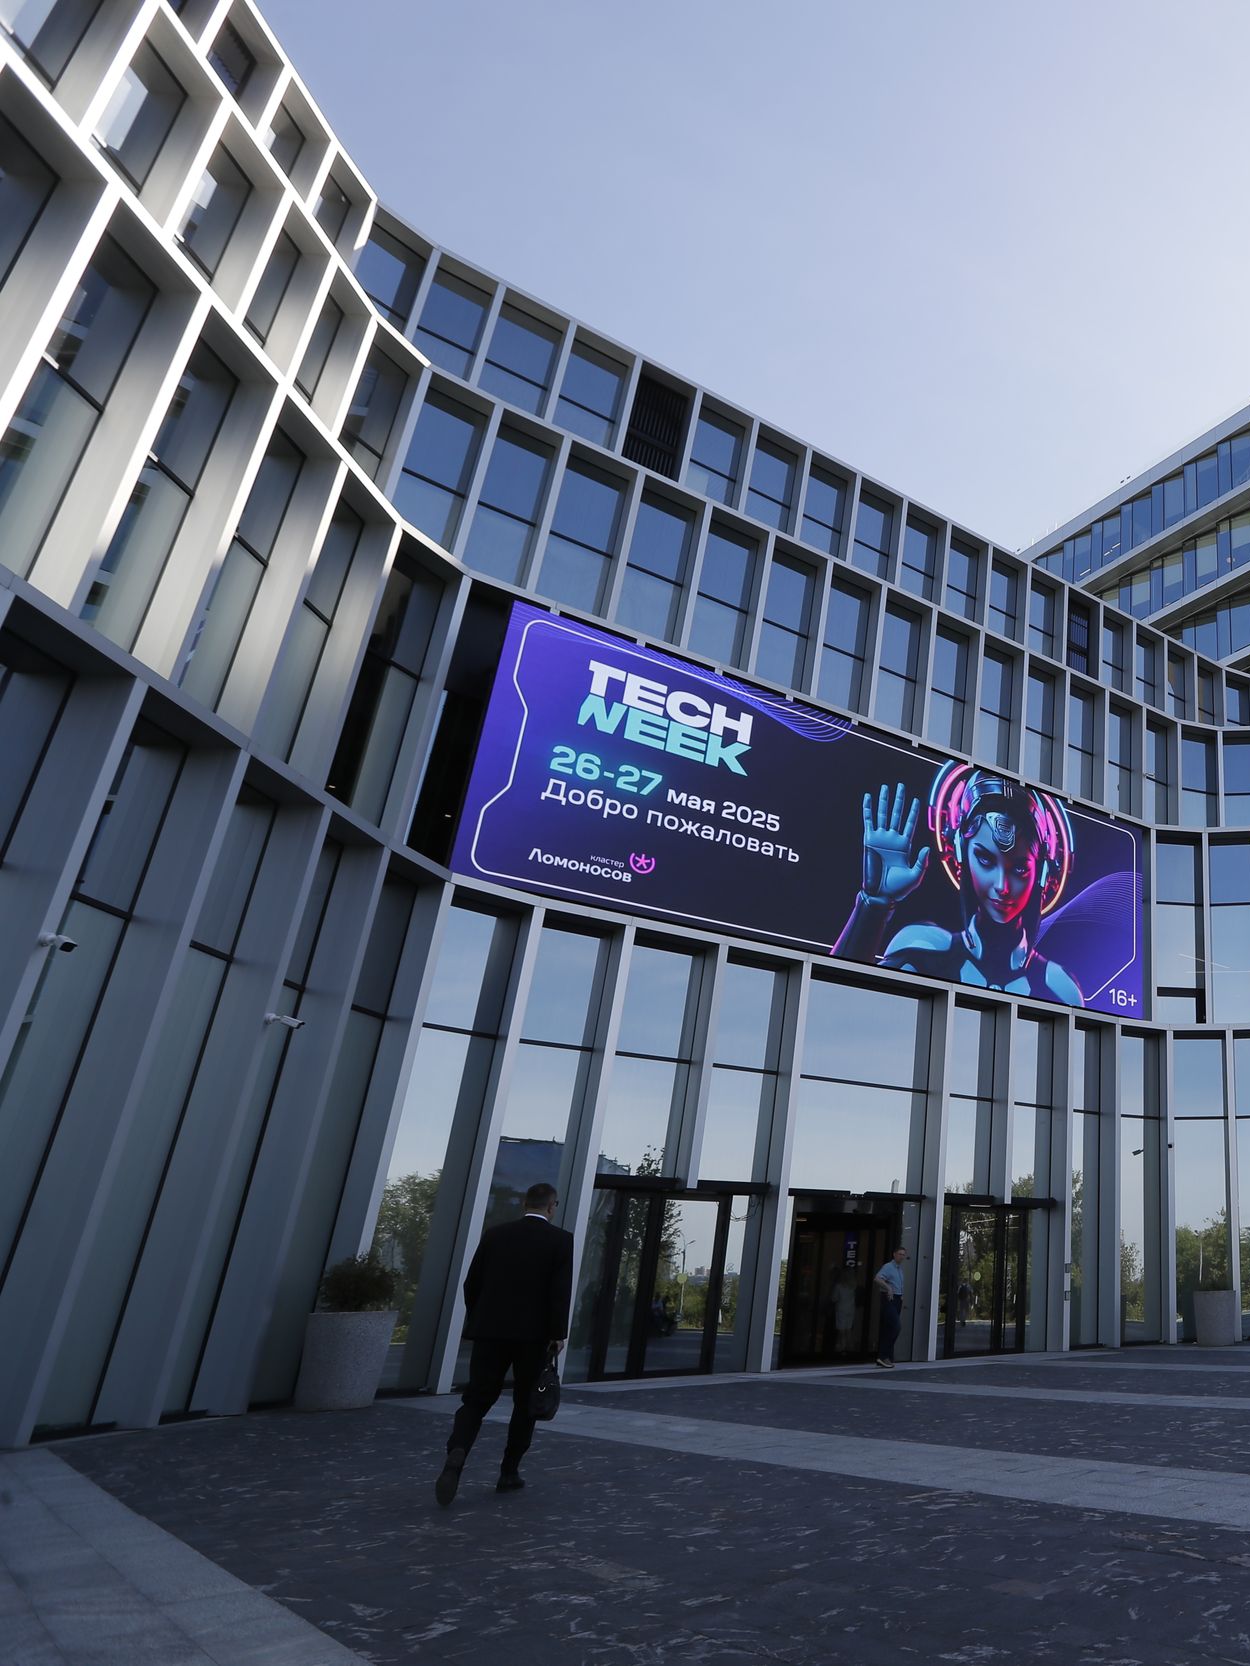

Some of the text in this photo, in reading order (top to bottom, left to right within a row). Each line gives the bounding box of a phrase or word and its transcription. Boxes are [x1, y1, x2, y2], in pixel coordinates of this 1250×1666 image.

[578, 694, 752, 776] WEEK
[589, 660, 753, 744] TECH
[540, 778, 800, 863] Добро пожаловать
[550, 745, 780, 832] 26-27 мая 2025
[528, 848, 632, 883] Ломоносов
[590, 855, 625, 868] кластер
[1109, 988, 1137, 1007] 16+
